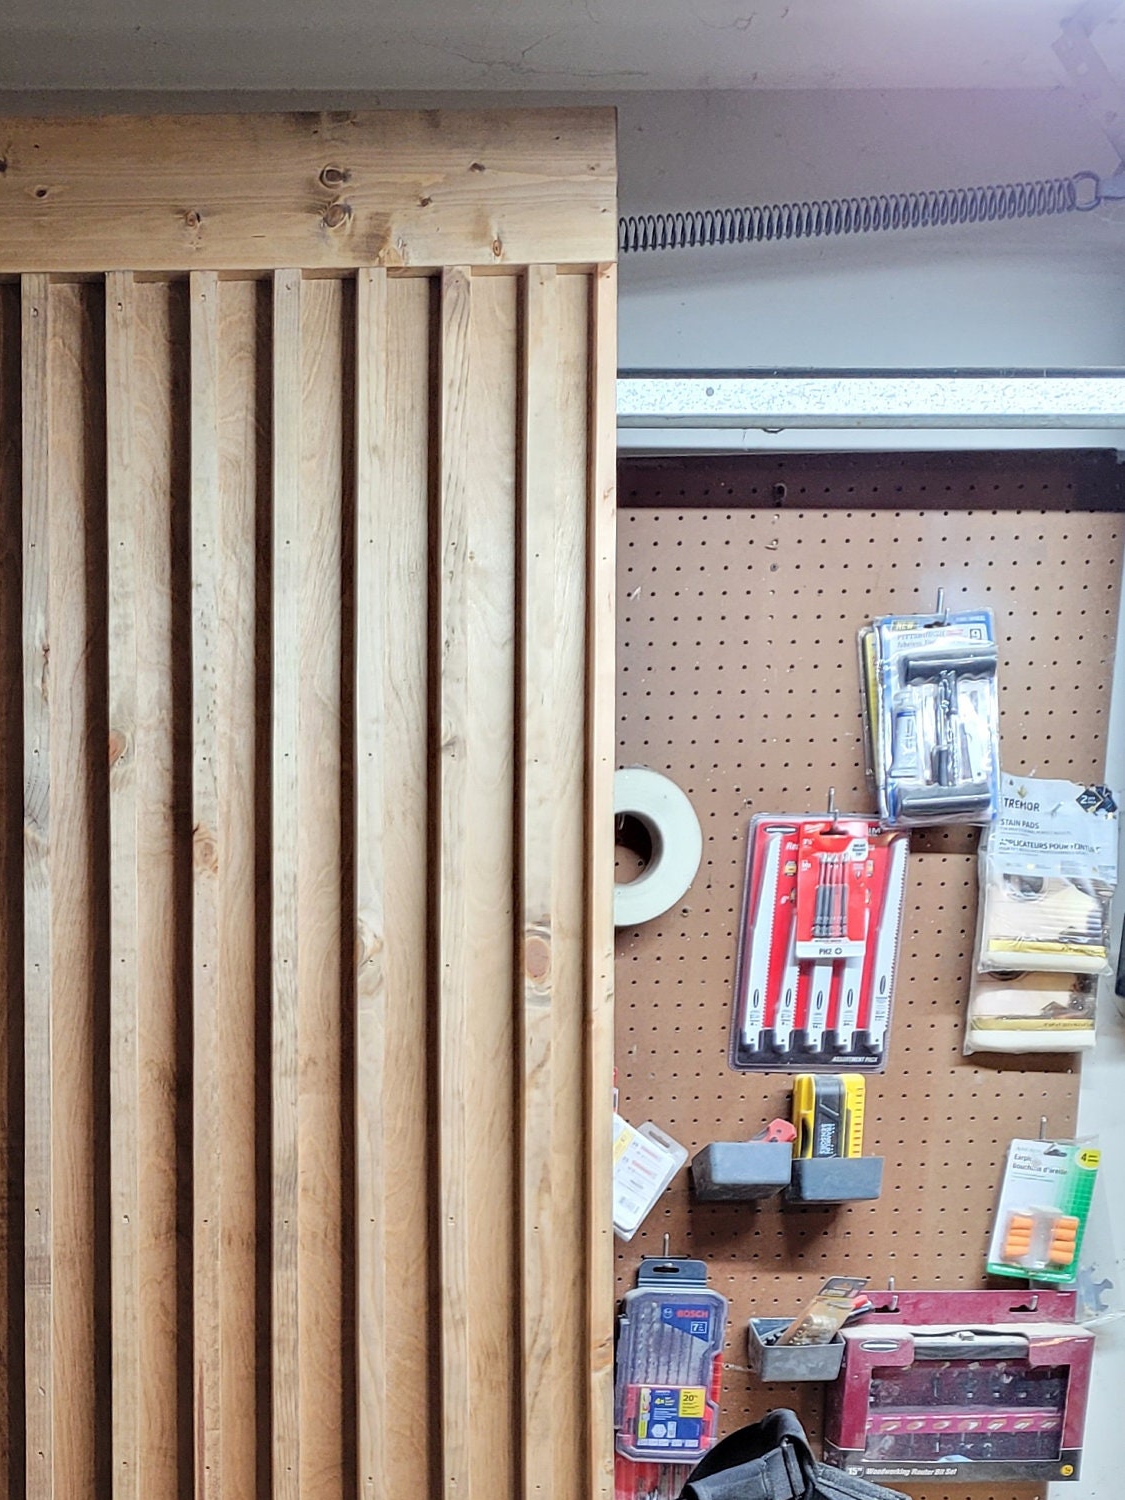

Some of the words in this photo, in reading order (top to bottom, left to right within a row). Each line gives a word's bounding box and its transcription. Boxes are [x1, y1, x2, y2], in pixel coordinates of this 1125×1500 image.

[1003, 797, 1041, 812] TREMOR
[999, 818, 1021, 827] STAIN
[1021, 819, 1040, 829] PADS
[1080, 1152, 1087, 1162] 4
[676, 1309, 709, 1318] BOSCH
[682, 1394, 695, 1403] 20
[865, 1468, 911, 1477] Woodworking
